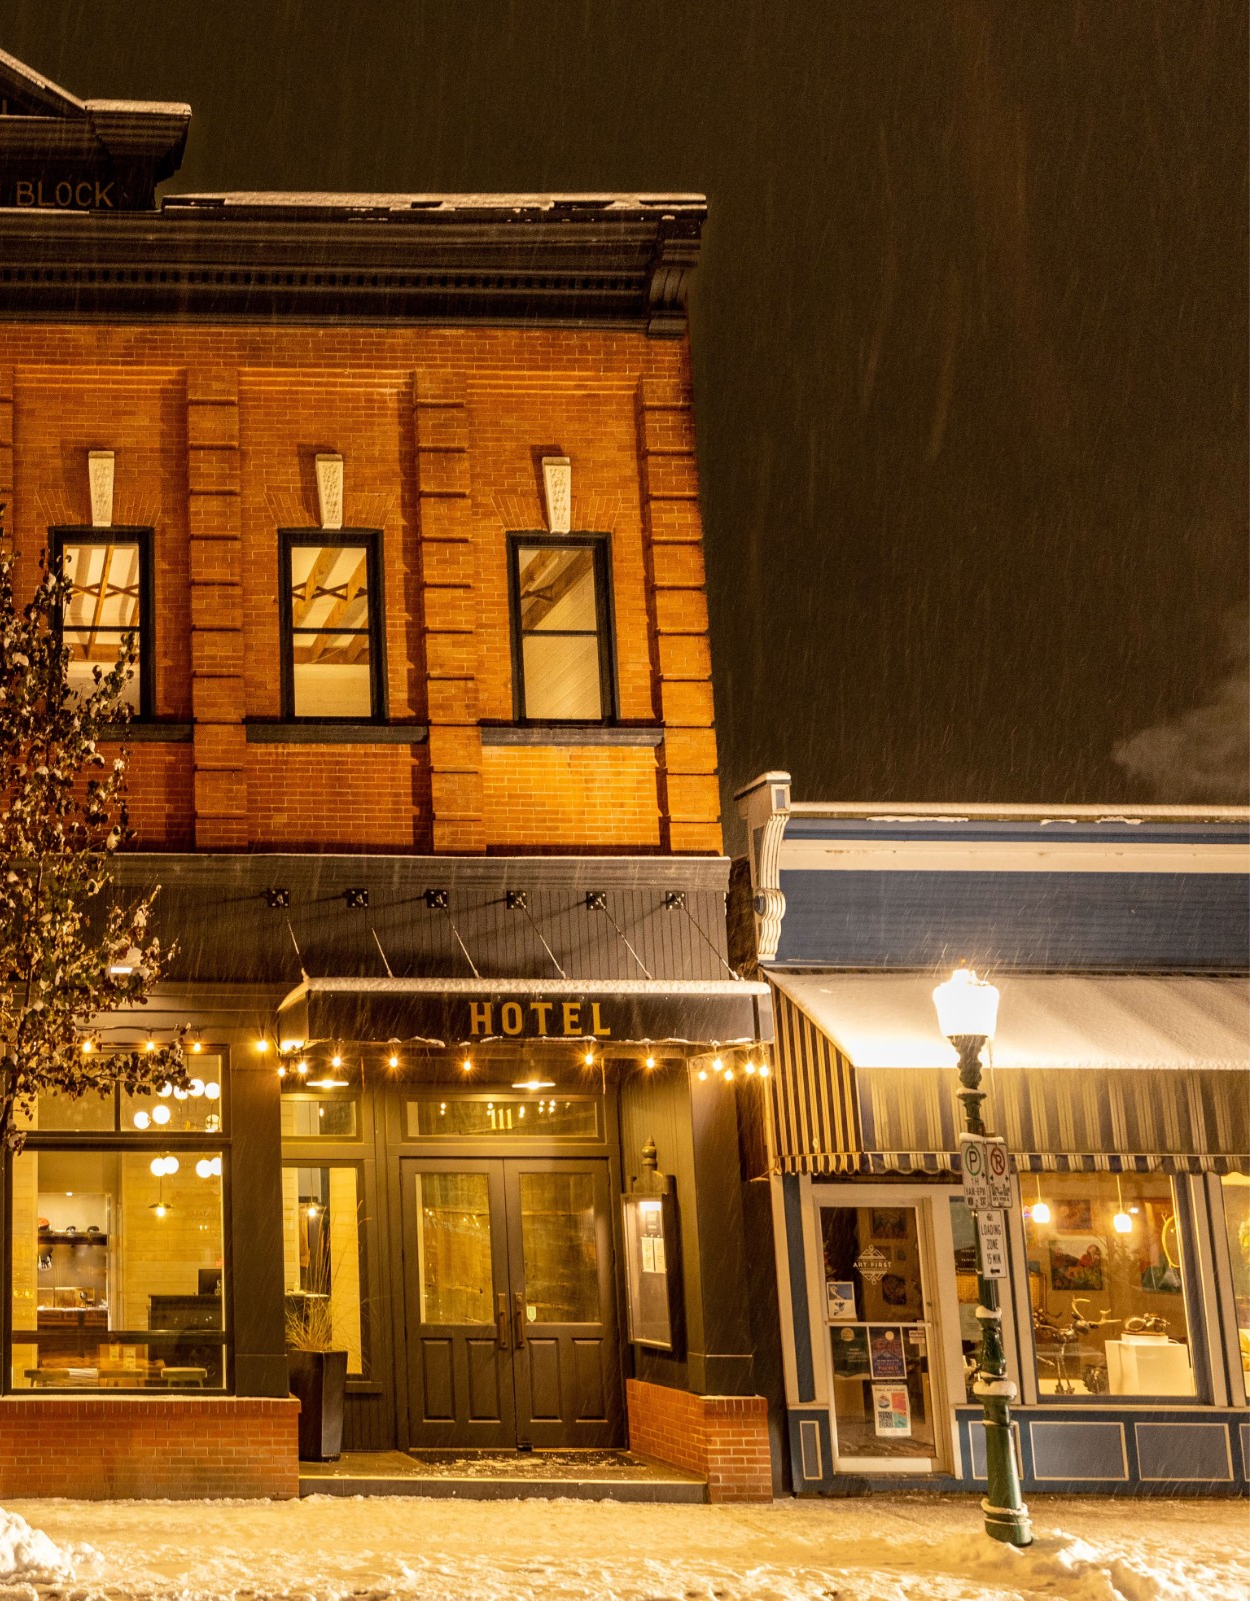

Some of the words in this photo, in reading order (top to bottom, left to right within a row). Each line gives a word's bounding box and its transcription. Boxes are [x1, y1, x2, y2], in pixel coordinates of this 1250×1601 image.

[15, 180, 115, 208] BLOCK
[469, 1001, 611, 1036] HOTEL
[490, 1108, 513, 1130] 111
[981, 1224, 1002, 1236] LOADING
[986, 1238, 999, 1250] ZONE
[986, 1253, 992, 1265] 15
[993, 1253, 1001, 1265] MIN
